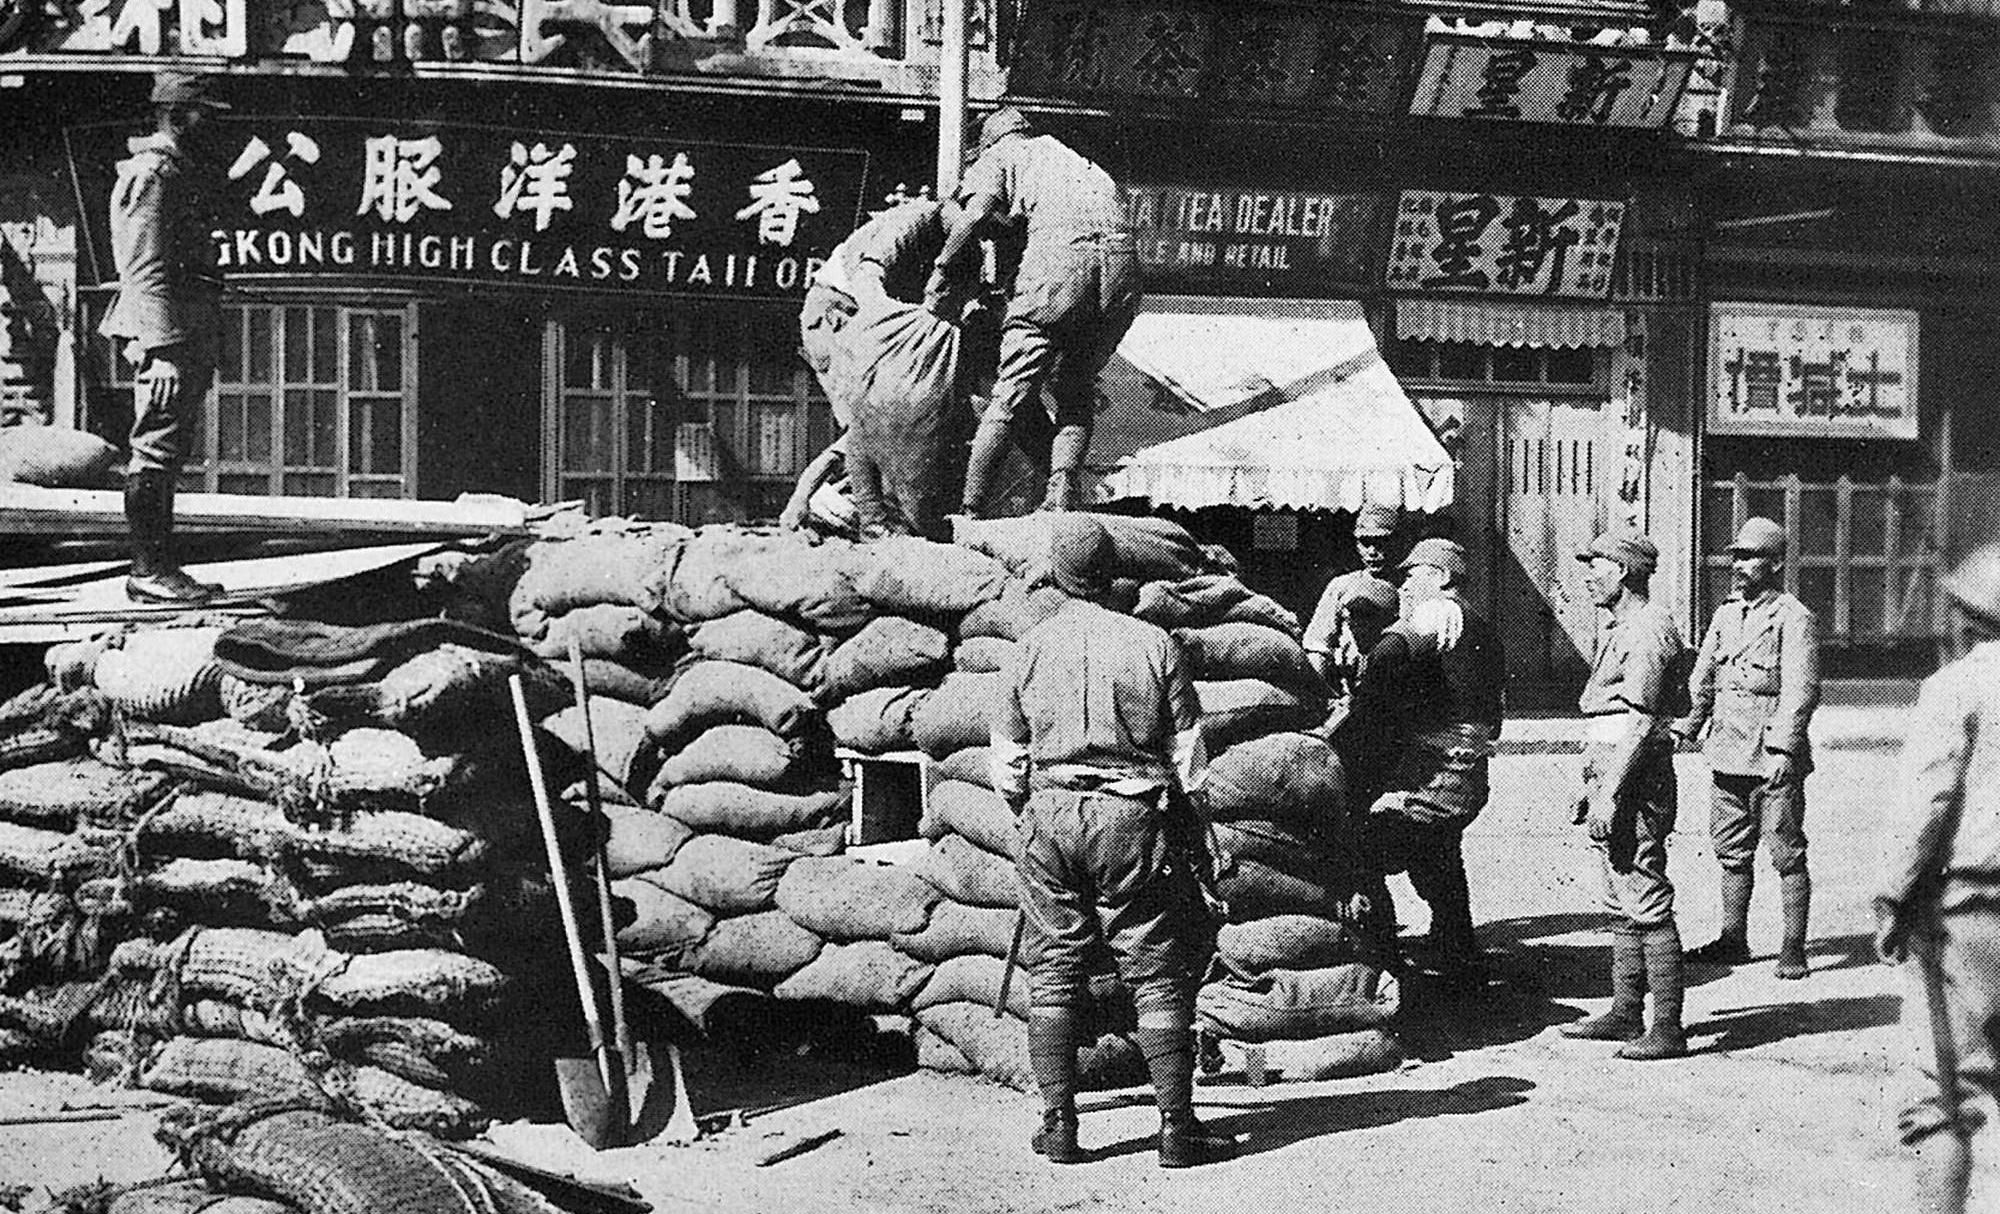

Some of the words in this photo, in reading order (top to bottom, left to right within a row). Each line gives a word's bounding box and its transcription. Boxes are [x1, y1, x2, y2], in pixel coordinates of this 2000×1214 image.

[1176, 191, 1223, 232] TEA
[1235, 194, 1335, 238] DEALER
[371, 231, 473, 270] HIGH
[491, 239, 642, 282] CLASS
[1225, 243, 1290, 269] RETAIL
